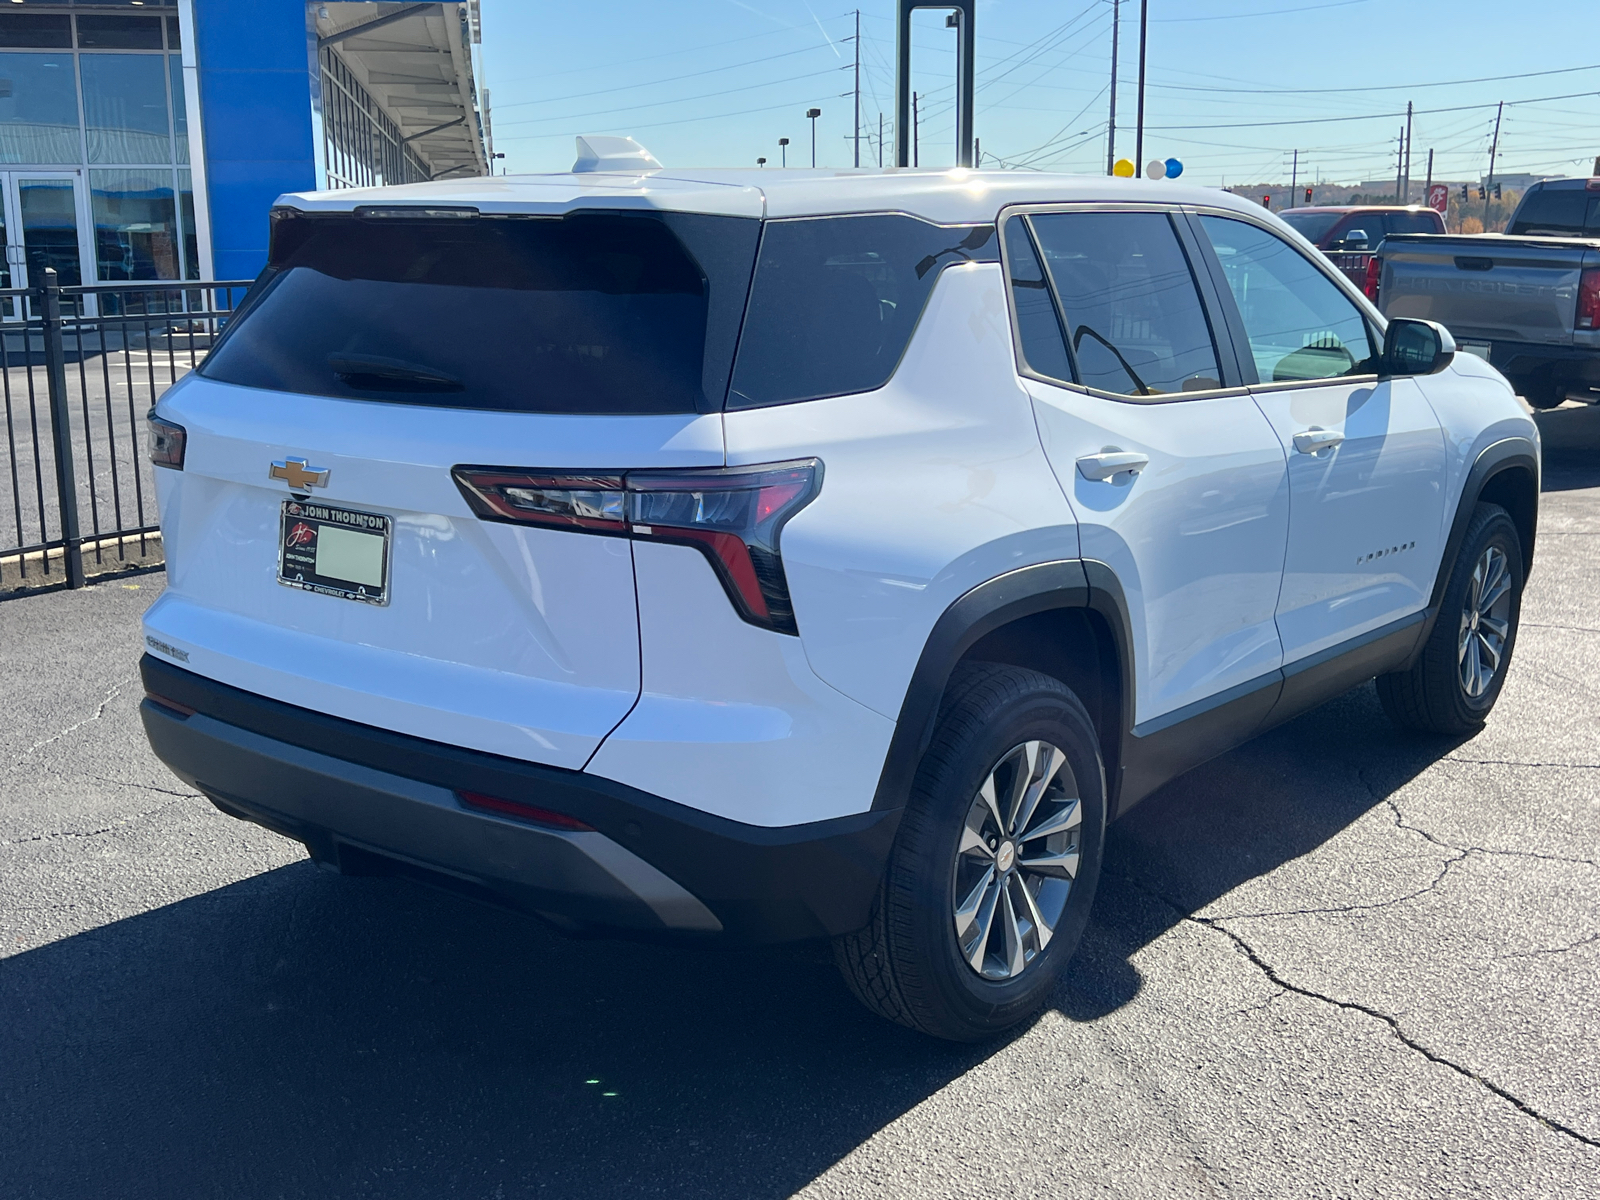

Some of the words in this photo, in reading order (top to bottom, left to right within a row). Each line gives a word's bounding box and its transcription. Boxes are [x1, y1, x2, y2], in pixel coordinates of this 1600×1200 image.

[304, 506, 329, 519] JOHN
[331, 510, 383, 528] THORNTON
[314, 586, 345, 598] CHEVROLET
